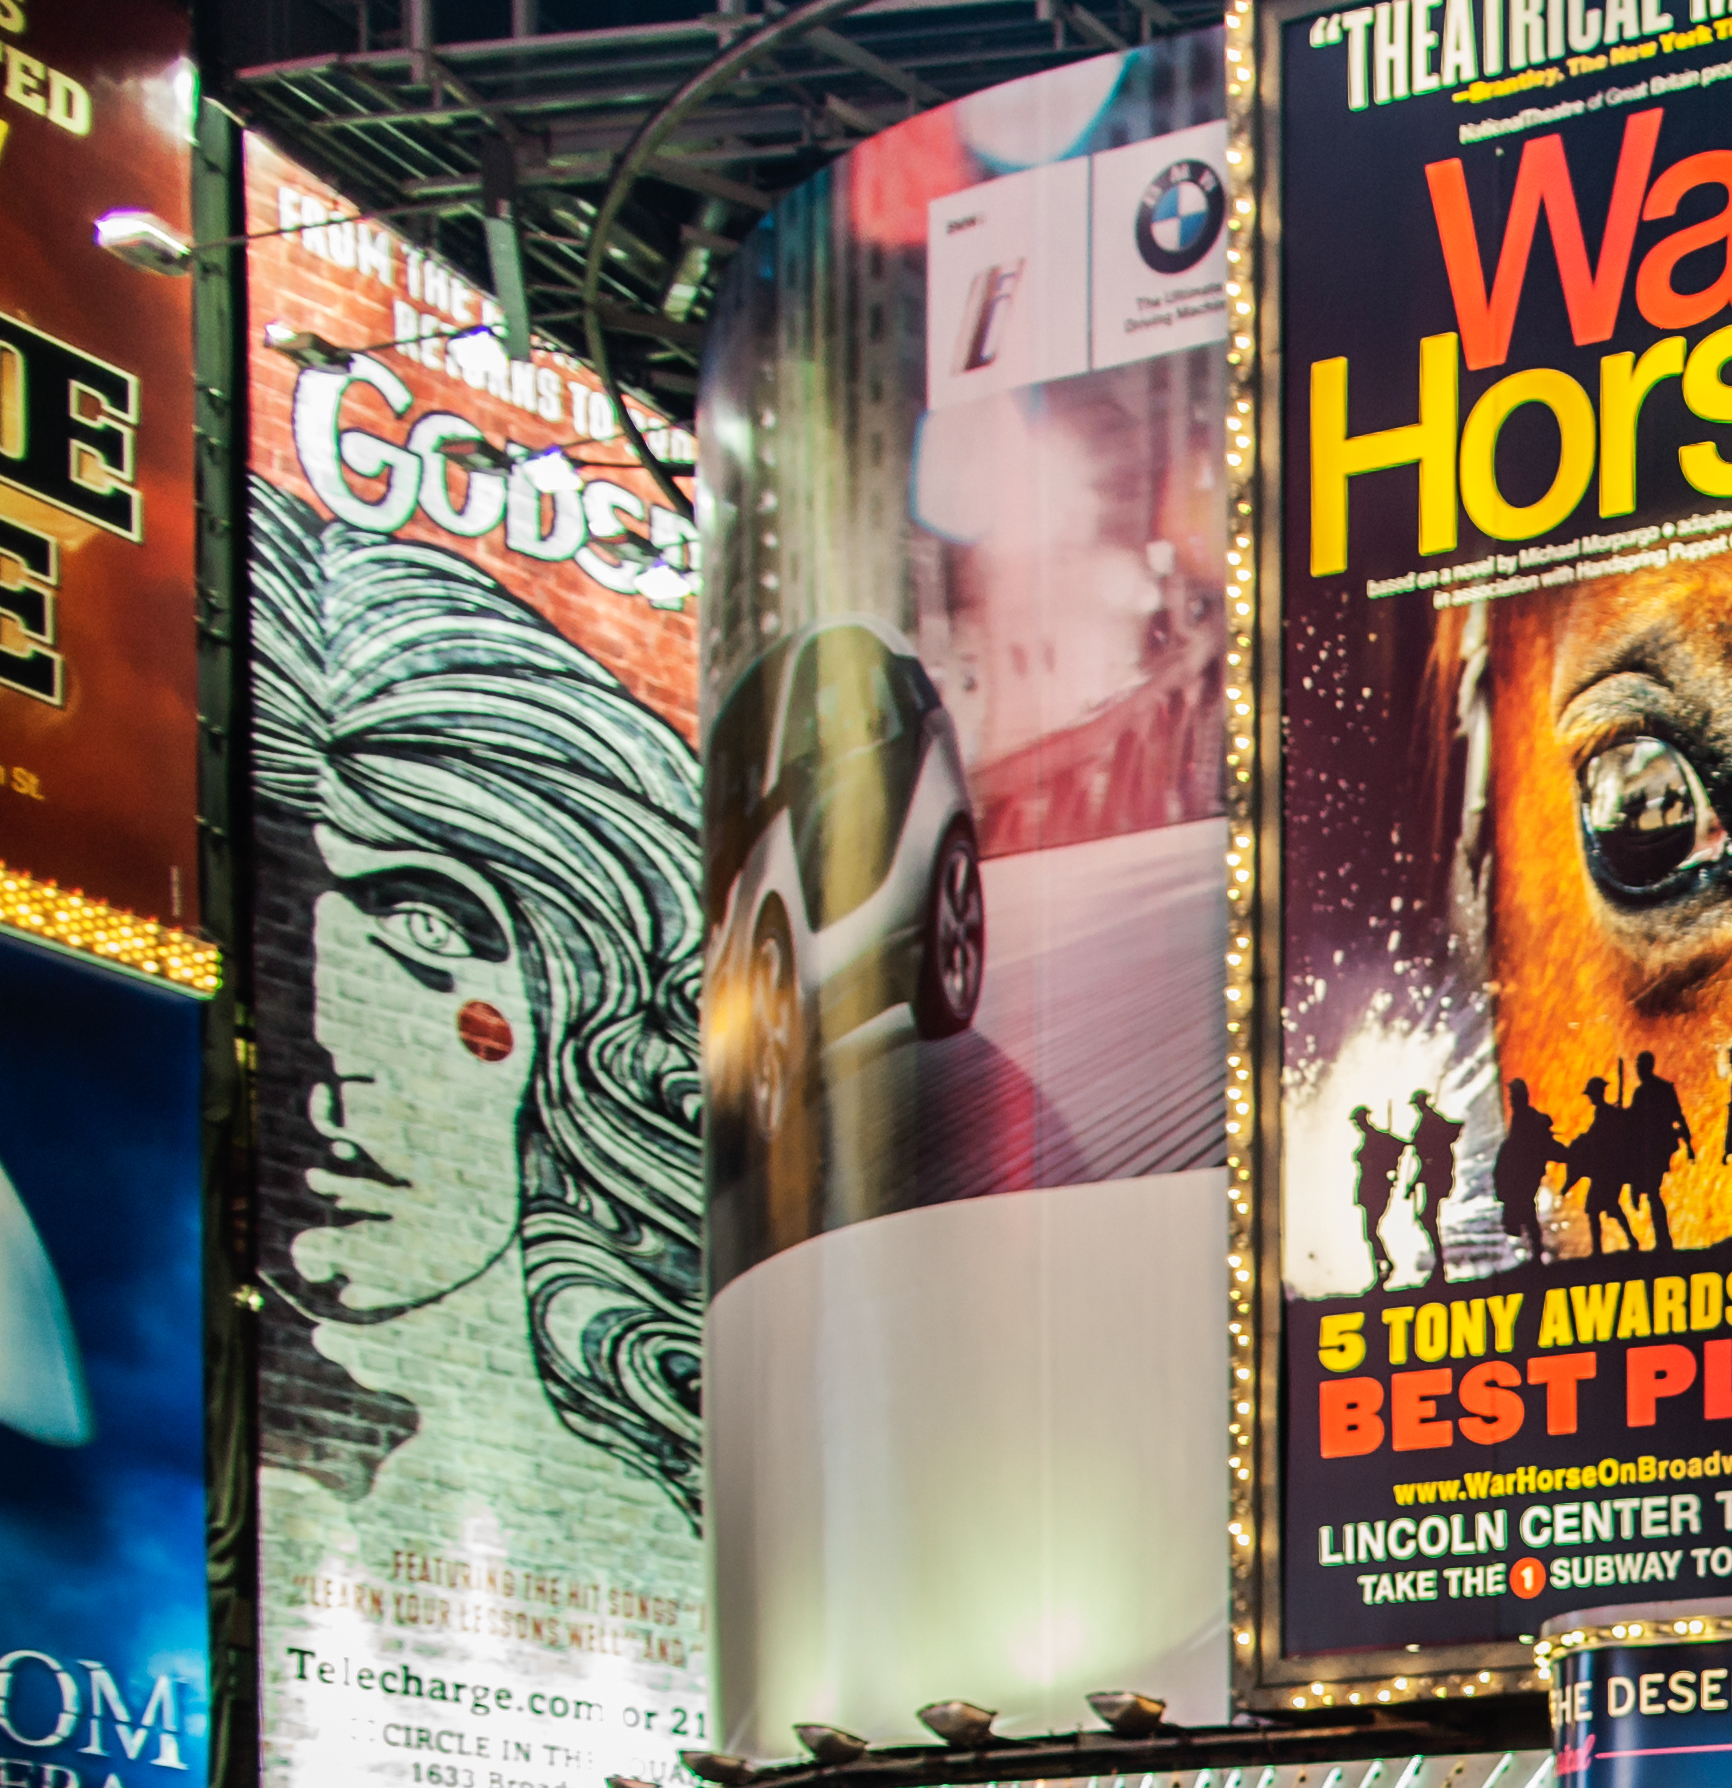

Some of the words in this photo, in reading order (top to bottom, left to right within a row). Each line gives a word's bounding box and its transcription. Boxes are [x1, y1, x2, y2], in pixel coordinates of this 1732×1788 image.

[1567, 55, 1608, 77] The
[1610, 38, 1658, 66] New
[1660, 25, 1713, 54] York
[1606, 82, 1648, 106] Great
[1650, 69, 1699, 97] Britain
[278, 184, 393, 286] FROM
[402, 243, 471, 322] THE
[567, 381, 618, 441] TO
[1367, 570, 1417, 599] based
[1417, 571, 1438, 590] on
[1440, 567, 1452, 586] a
[1452, 556, 1495, 582] novel
[1497, 553, 1518, 576] by
[1519, 540, 1581, 570] Michael
[1581, 526, 1661, 558] Morpurgo
[1451, 574, 1540, 607] association
[1540, 565, 1575, 589] with
[1575, 547, 1669, 581] Handspring
[1668, 535, 1728, 564] Puppet
[1317, 1312, 1368, 1372] 5
[1382, 1293, 1524, 1365] TONY
[1318, 1352, 1598, 1459] BEST
[1318, 1509, 1508, 1567] LINCOLN
[1519, 1494, 1701, 1550] CENTER
[392, 1550, 516, 1599] FEATURING
[524, 1571, 560, 1606] THE
[567, 1583, 603, 1613] HIT
[608, 1585, 681, 1627] SONGS
[1358, 1571, 1437, 1606] TAKE
[1445, 1565, 1506, 1599] THE
[1550, 1552, 1679, 1590] SUBWAY
[393, 1588, 452, 1630] YOUR
[459, 1603, 561, 1649] LESSONS
[642, 1628, 688, 1668] AND
[286, 1647, 604, 1723] Telecharge.com
[622, 1706, 661, 1731] or
[1550, 1680, 1594, 1729] HE
[382, 1723, 492, 1759] CIRCLE
[502, 1739, 532, 1764] IN
